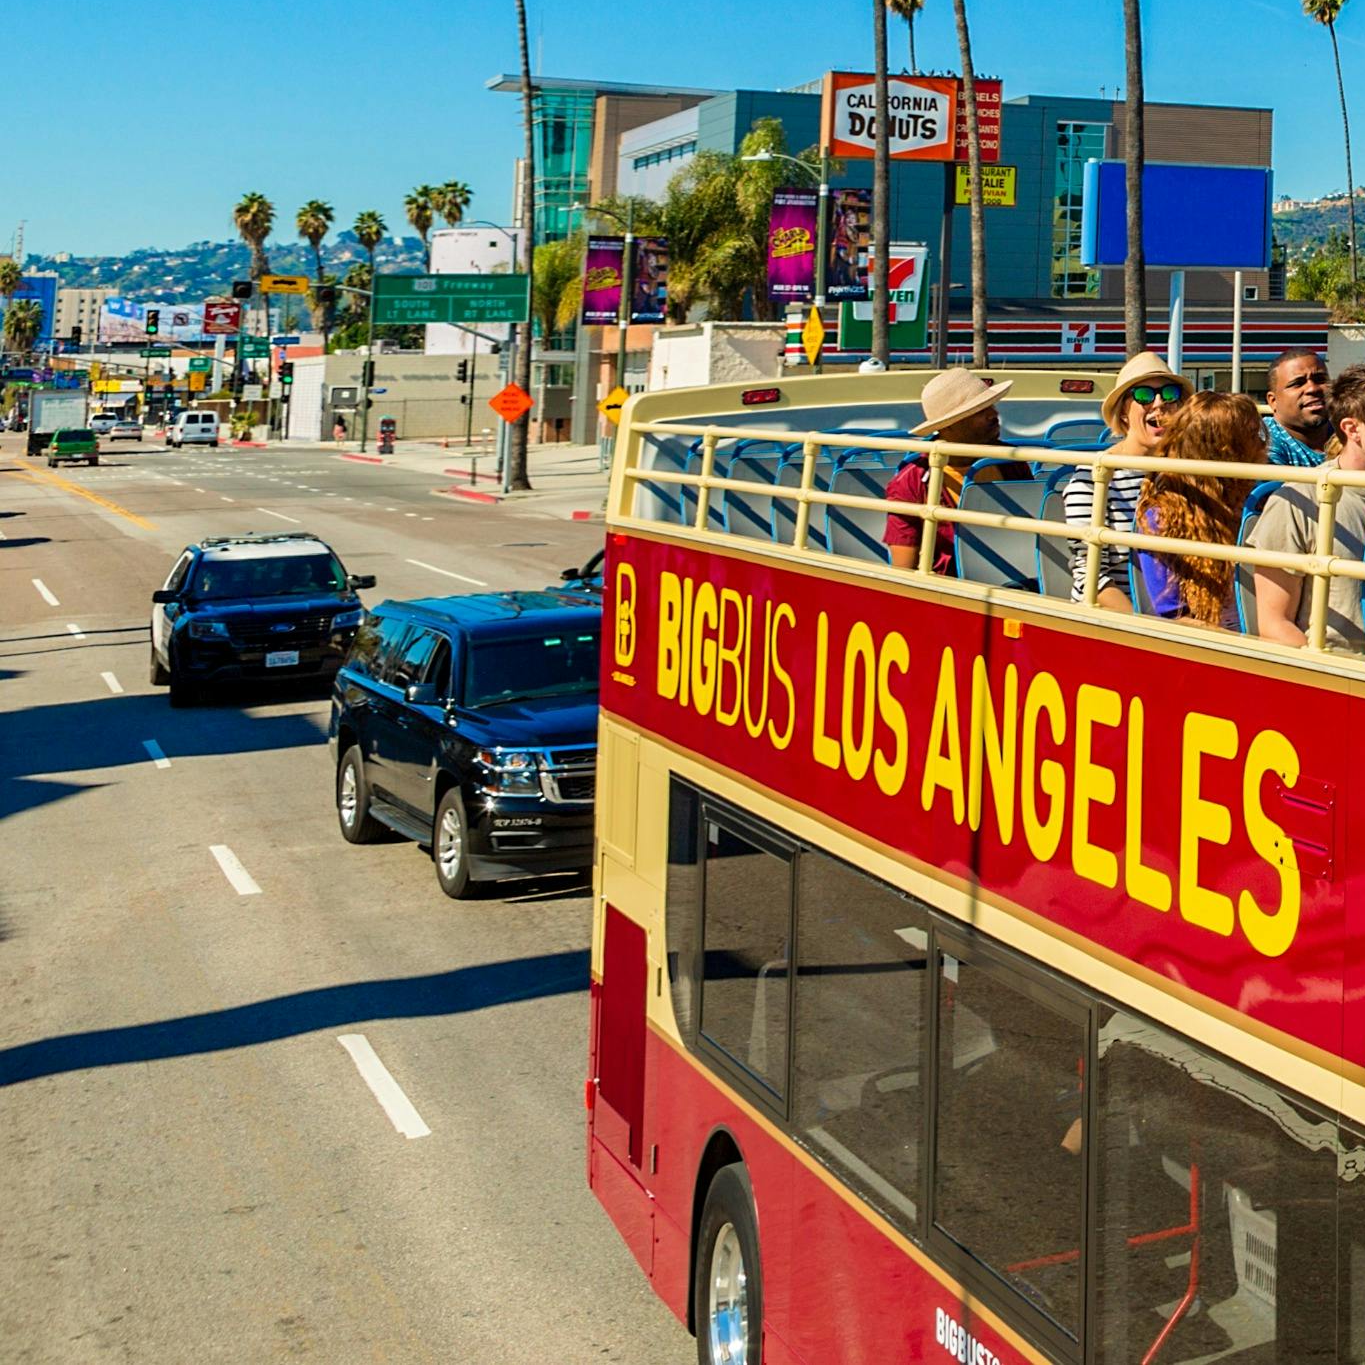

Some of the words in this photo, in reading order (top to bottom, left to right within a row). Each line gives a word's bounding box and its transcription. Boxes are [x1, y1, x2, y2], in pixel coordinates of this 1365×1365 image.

[847, 94, 938, 112] CALORNIA
[443, 280, 494, 291] Freeway
[393, 299, 430, 309] SOUTH
[469, 299, 506, 308] NORTH
[406, 310, 437, 319] LANE
[485, 309, 514, 318] LANE
[812, 611, 910, 797] LOS
[920, 645, 1302, 958] ANGELES
